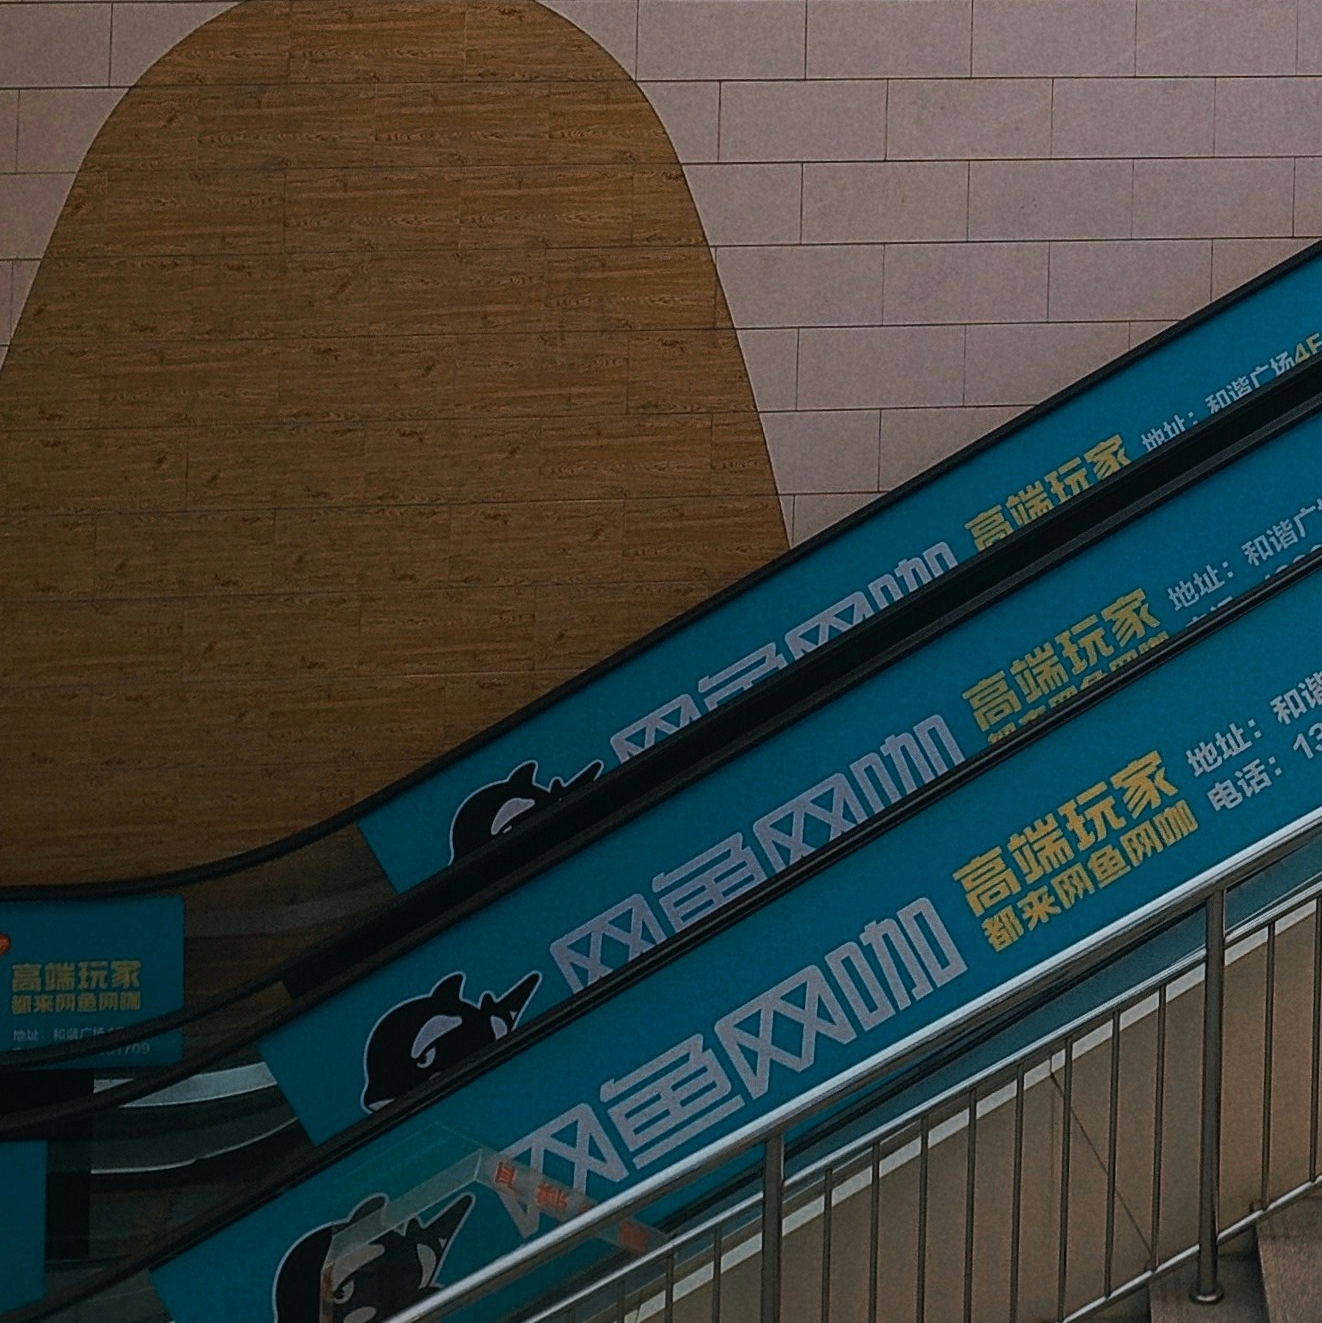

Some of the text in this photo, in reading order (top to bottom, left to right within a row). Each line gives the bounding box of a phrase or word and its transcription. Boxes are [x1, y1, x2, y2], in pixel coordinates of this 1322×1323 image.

[961, 587, 1163, 734] 高端玩家
[980, 798, 1199, 954] 都来网鱼网咖
[11, 990, 141, 1015] 都来网鱼网咖
[12, 960, 141, 992] 高端玩家
[500, 896, 969, 1241] 网鱼网咖
[952, 749, 1181, 918] 高端玩家
